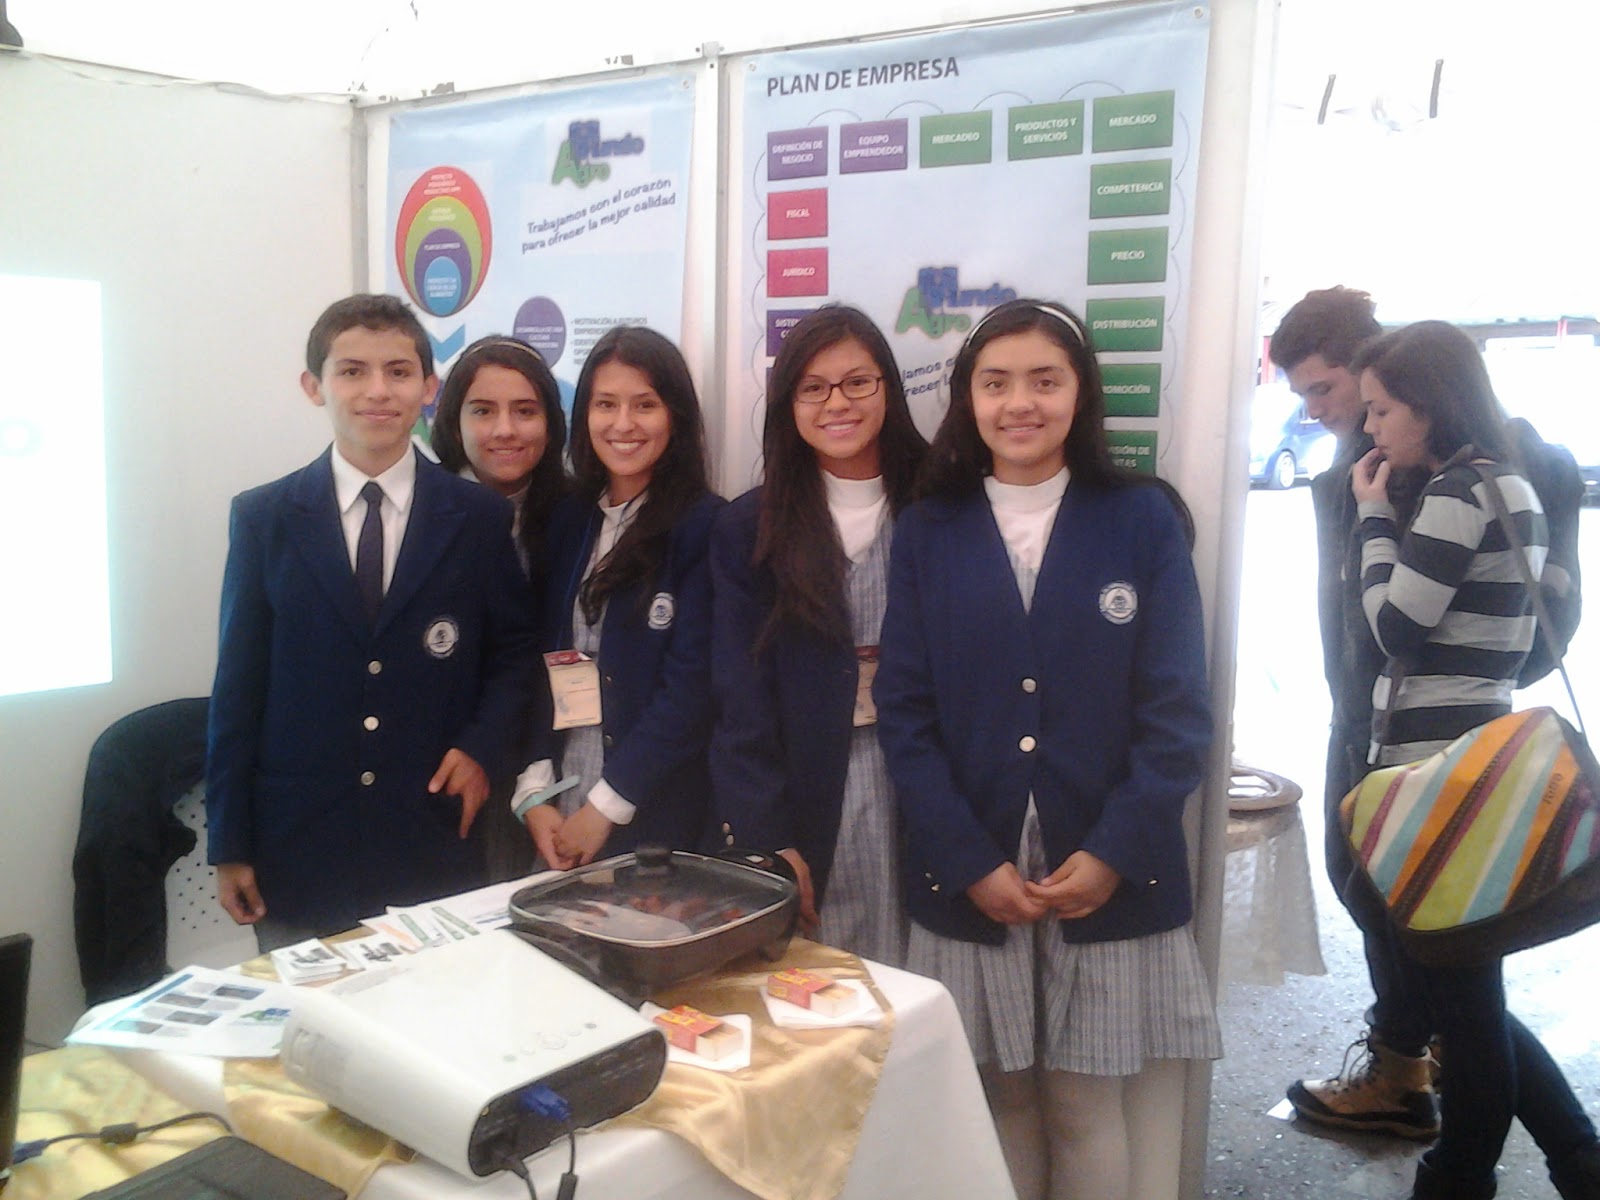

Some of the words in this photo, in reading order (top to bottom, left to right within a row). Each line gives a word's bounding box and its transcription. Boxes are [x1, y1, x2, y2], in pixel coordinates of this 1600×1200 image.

[767, 73, 819, 97] PLAN
[825, 69, 853, 91] DE
[857, 56, 960, 87] EMPRESA
[1015, 118, 1069, 132] PRODUCTOS
[1109, 114, 1157, 127] MERCADO
[858, 134, 890, 146] EQUIPO
[932, 132, 980, 145] MERCADEO
[1023, 131, 1068, 145] SERVICIOS
[1096, 182, 1164, 196] COMPETENCIA
[528, 208, 587, 234] Trabajamos
[590, 199, 610, 213] con
[613, 190, 622, 203] el
[624, 178, 671, 198] corazón
[522, 239, 546, 254] para
[548, 224, 585, 246] ofrecer
[588, 219, 598, 231] la
[600, 206, 631, 225] mejor
[634, 193, 676, 212] calidad
[1111, 250, 1145, 261] PRECIO
[1093, 317, 1158, 330] DISTRIBUCIÓN
[902, 362, 942, 381] jamos
